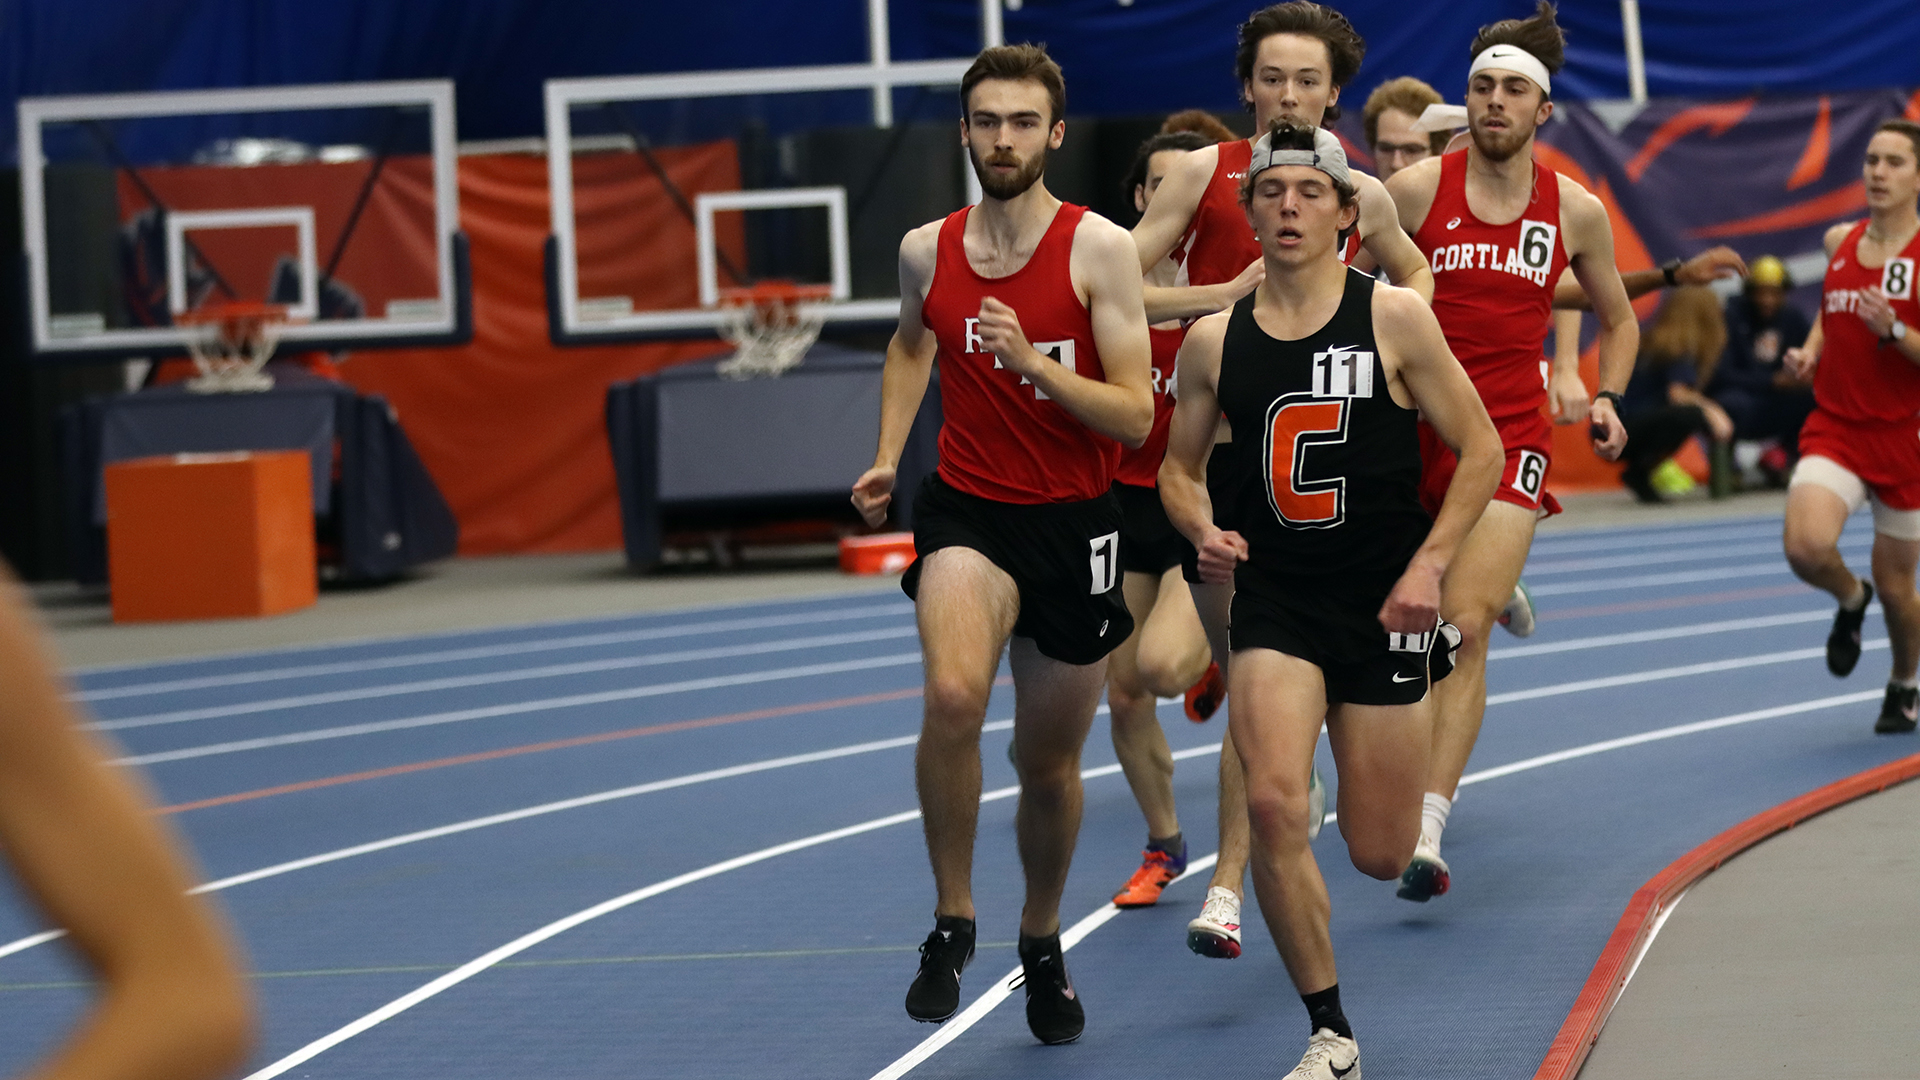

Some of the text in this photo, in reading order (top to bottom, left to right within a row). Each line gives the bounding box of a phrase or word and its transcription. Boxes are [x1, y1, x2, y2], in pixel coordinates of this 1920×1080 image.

[1522, 226, 1550, 268] 6
[1886, 262, 1907, 294] 8
[1316, 353, 1358, 395] 11
[1263, 391, 1352, 531] C
[1521, 454, 1543, 495] 6
[1095, 538, 1112, 590] 1
